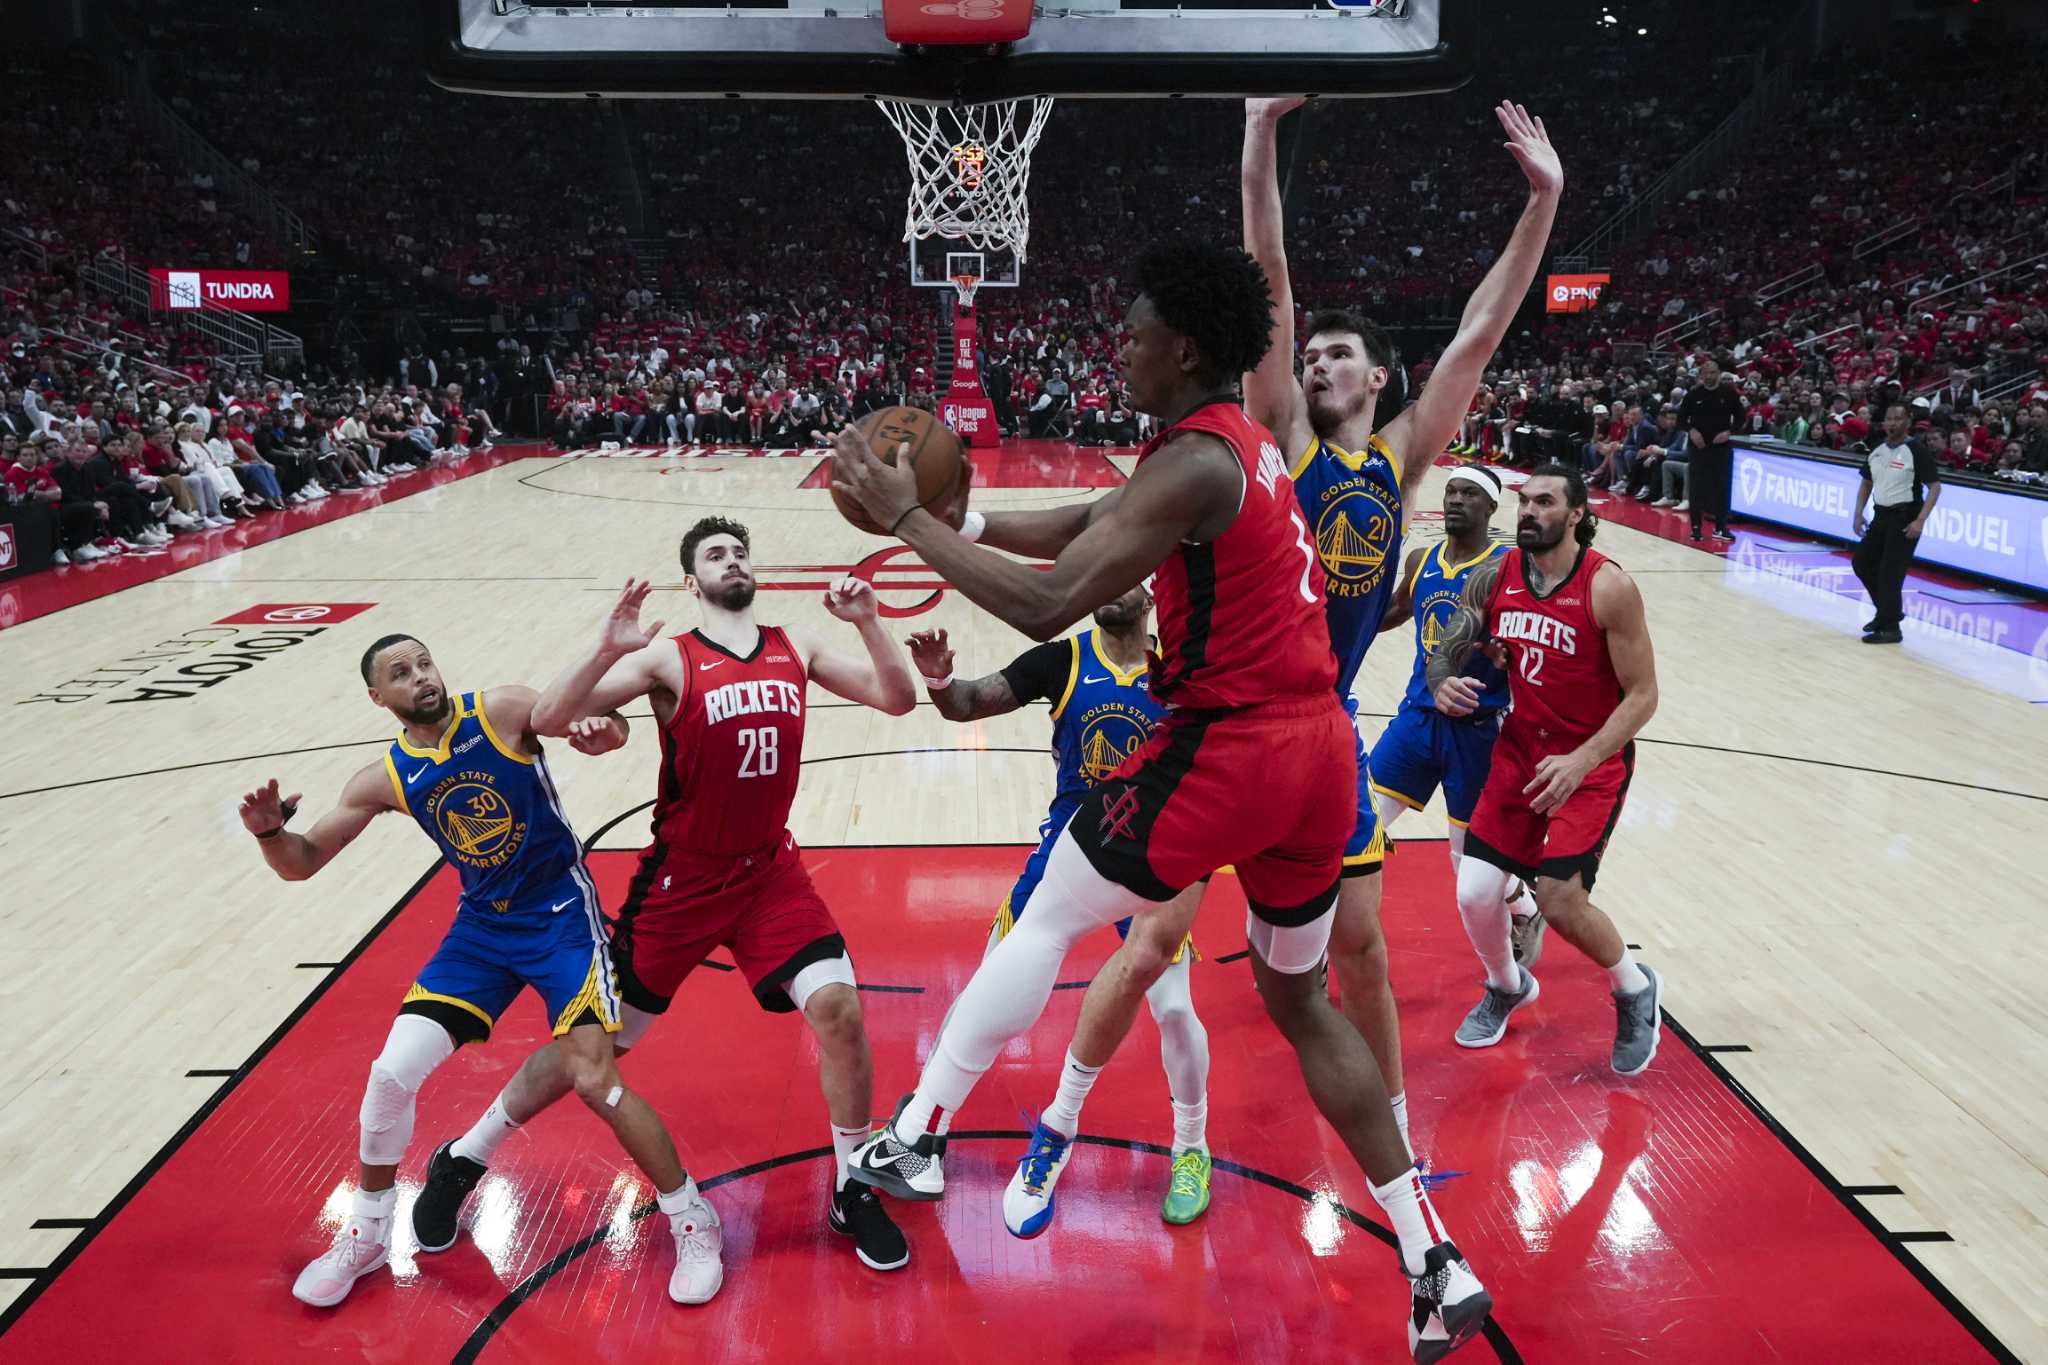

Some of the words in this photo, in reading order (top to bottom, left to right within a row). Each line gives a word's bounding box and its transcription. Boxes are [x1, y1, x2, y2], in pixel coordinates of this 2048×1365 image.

[206, 282, 275, 299] TUNDRA
[952, 380, 978, 390] Google
[959, 405, 987, 420] League
[959, 419, 978, 433] Pass
[1320, 476, 1366, 502] GOLDEN
[1369, 482, 1400, 512] STATE
[1765, 473, 1849, 518] FANDUEL
[1368, 515, 1387, 542] 21
[1921, 506, 2016, 556] NDUEL
[1421, 590, 1450, 609] GOLDEN
[1496, 611, 1577, 655] ROCKETS
[14, 627, 240, 705] CENTER
[107, 627, 329, 704] TOYOTA
[1519, 642, 1544, 687] 12
[704, 680, 801, 726] ROCKETS
[1081, 703, 1124, 722] GOLDEN
[1128, 706, 1156, 731] STATE
[453, 734, 484, 755] Rakuten
[737, 726, 778, 778] 28
[427, 776, 456, 813] GOLDEN
[459, 771, 496, 785] STATE
[467, 791, 497, 818] 30
[456, 822, 528, 868] WARRIORS
